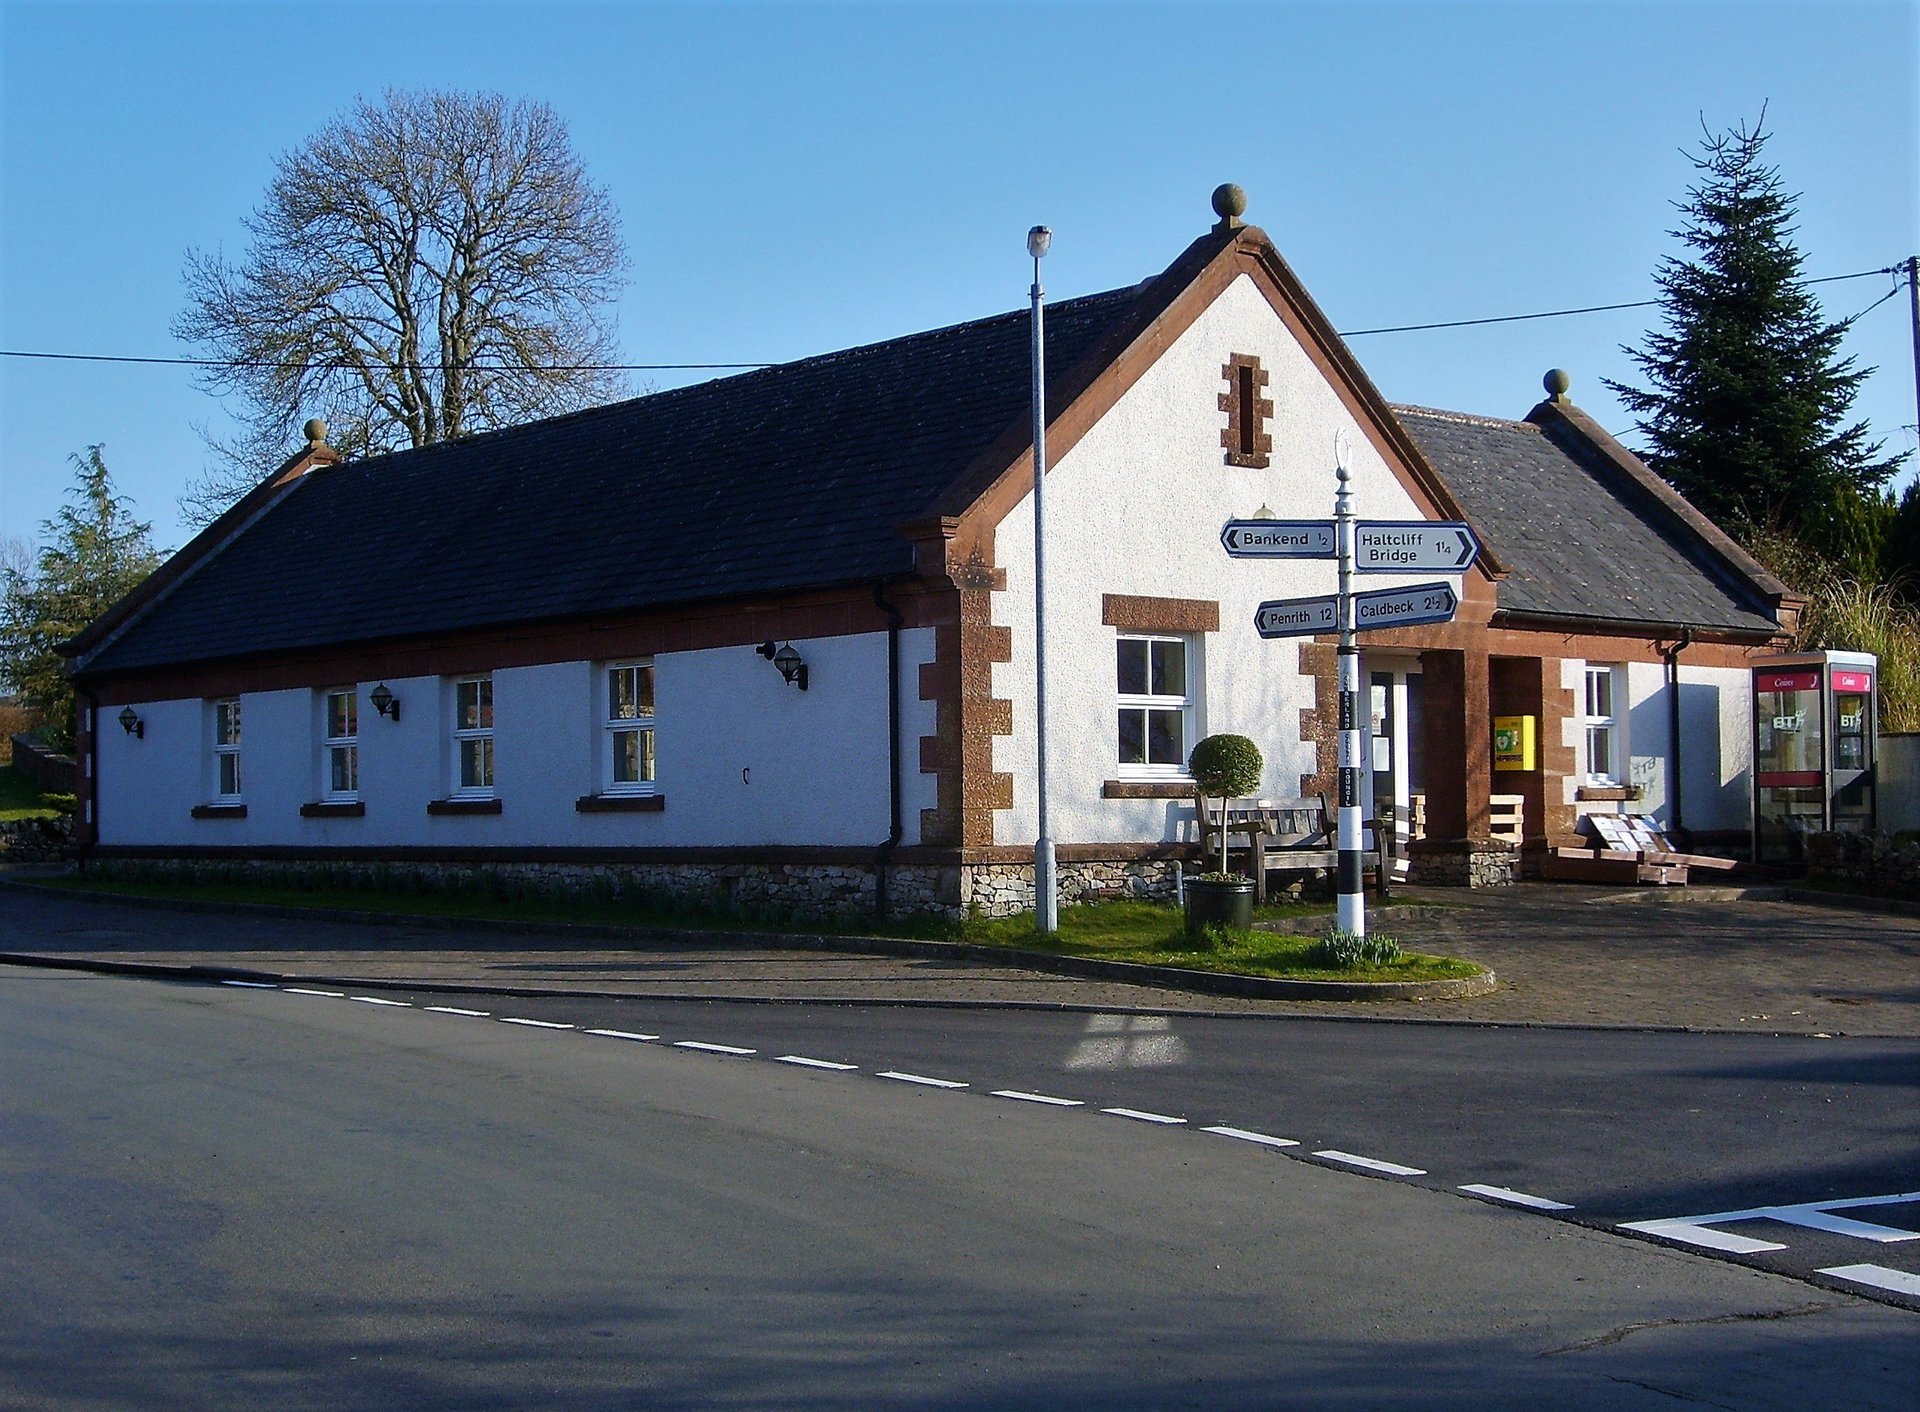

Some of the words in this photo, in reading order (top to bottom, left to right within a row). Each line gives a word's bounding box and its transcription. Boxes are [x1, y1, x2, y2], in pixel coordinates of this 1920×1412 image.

[1243, 532, 1309, 545] Bankend
[1362, 533, 1423, 546] Haltcliff
[1369, 549, 1418, 564] Bridge
[1270, 610, 1311, 625] Penrith
[1319, 607, 1333, 621] 12
[1360, 600, 1414, 618] Caldbeck
[1773, 716, 1796, 729] BT
[1841, 714, 1856, 727] BT
[1344, 768, 1352, 807] COUNCIL
